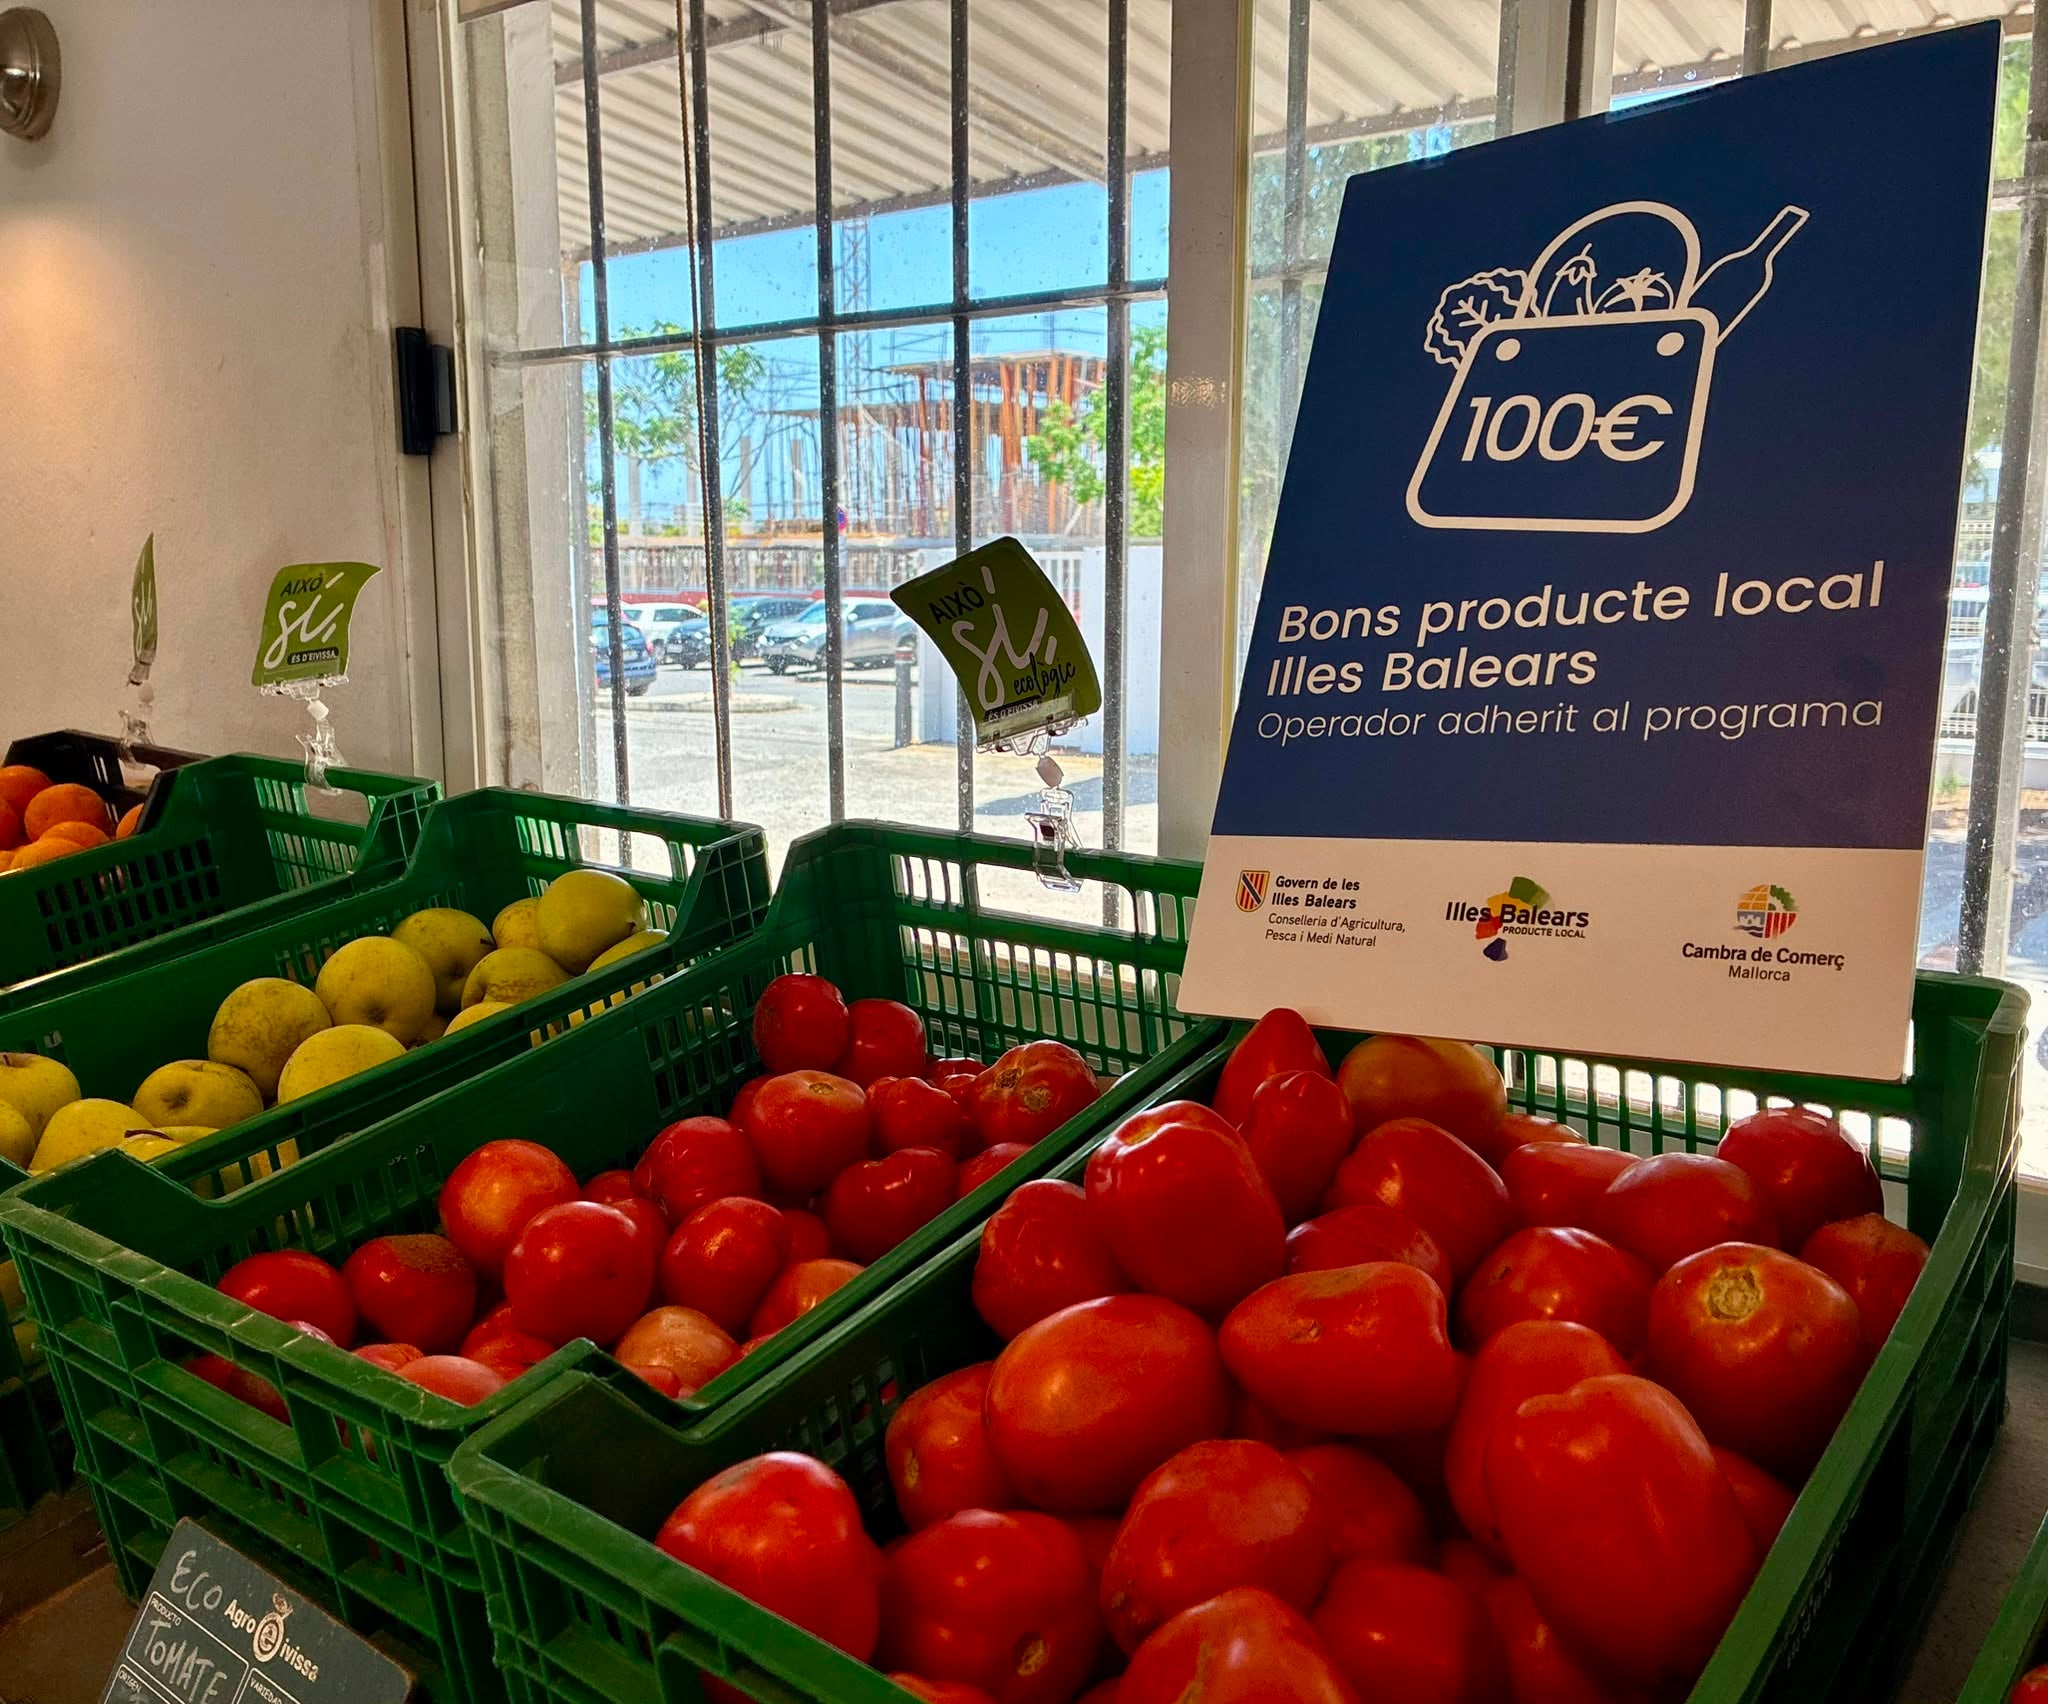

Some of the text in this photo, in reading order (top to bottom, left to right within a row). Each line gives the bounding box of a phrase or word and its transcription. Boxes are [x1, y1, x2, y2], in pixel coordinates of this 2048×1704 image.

[1460, 392, 1674, 462] 100€
[927, 582, 985, 625] AIXÒ
[1277, 559, 1885, 648] Bons producte local
[1266, 646, 1598, 697] Illes Balears
[1257, 700, 1883, 748] Operador adherit al programa
[1275, 875, 1360, 892] Govern de les
[1271, 892, 1357, 910] Illes Balears
[1445, 901, 1590, 928] Illes Balears
[1268, 912, 1406, 933] Conselleria d'Agricultura,
[1502, 925, 1586, 939] PRODUCTE LOCAL
[1265, 929, 1377, 947] Pesca i Medi Natural
[1681, 942, 1845, 972] Cambra de Comerç
[1728, 964, 1791, 983] Mallorca
[170, 1549, 223, 1611] ECO
[150, 1597, 182, 1627] PRODUCTO
[223, 1598, 257, 1635] Agro
[118, 1670, 142, 1694] ORIGEN
